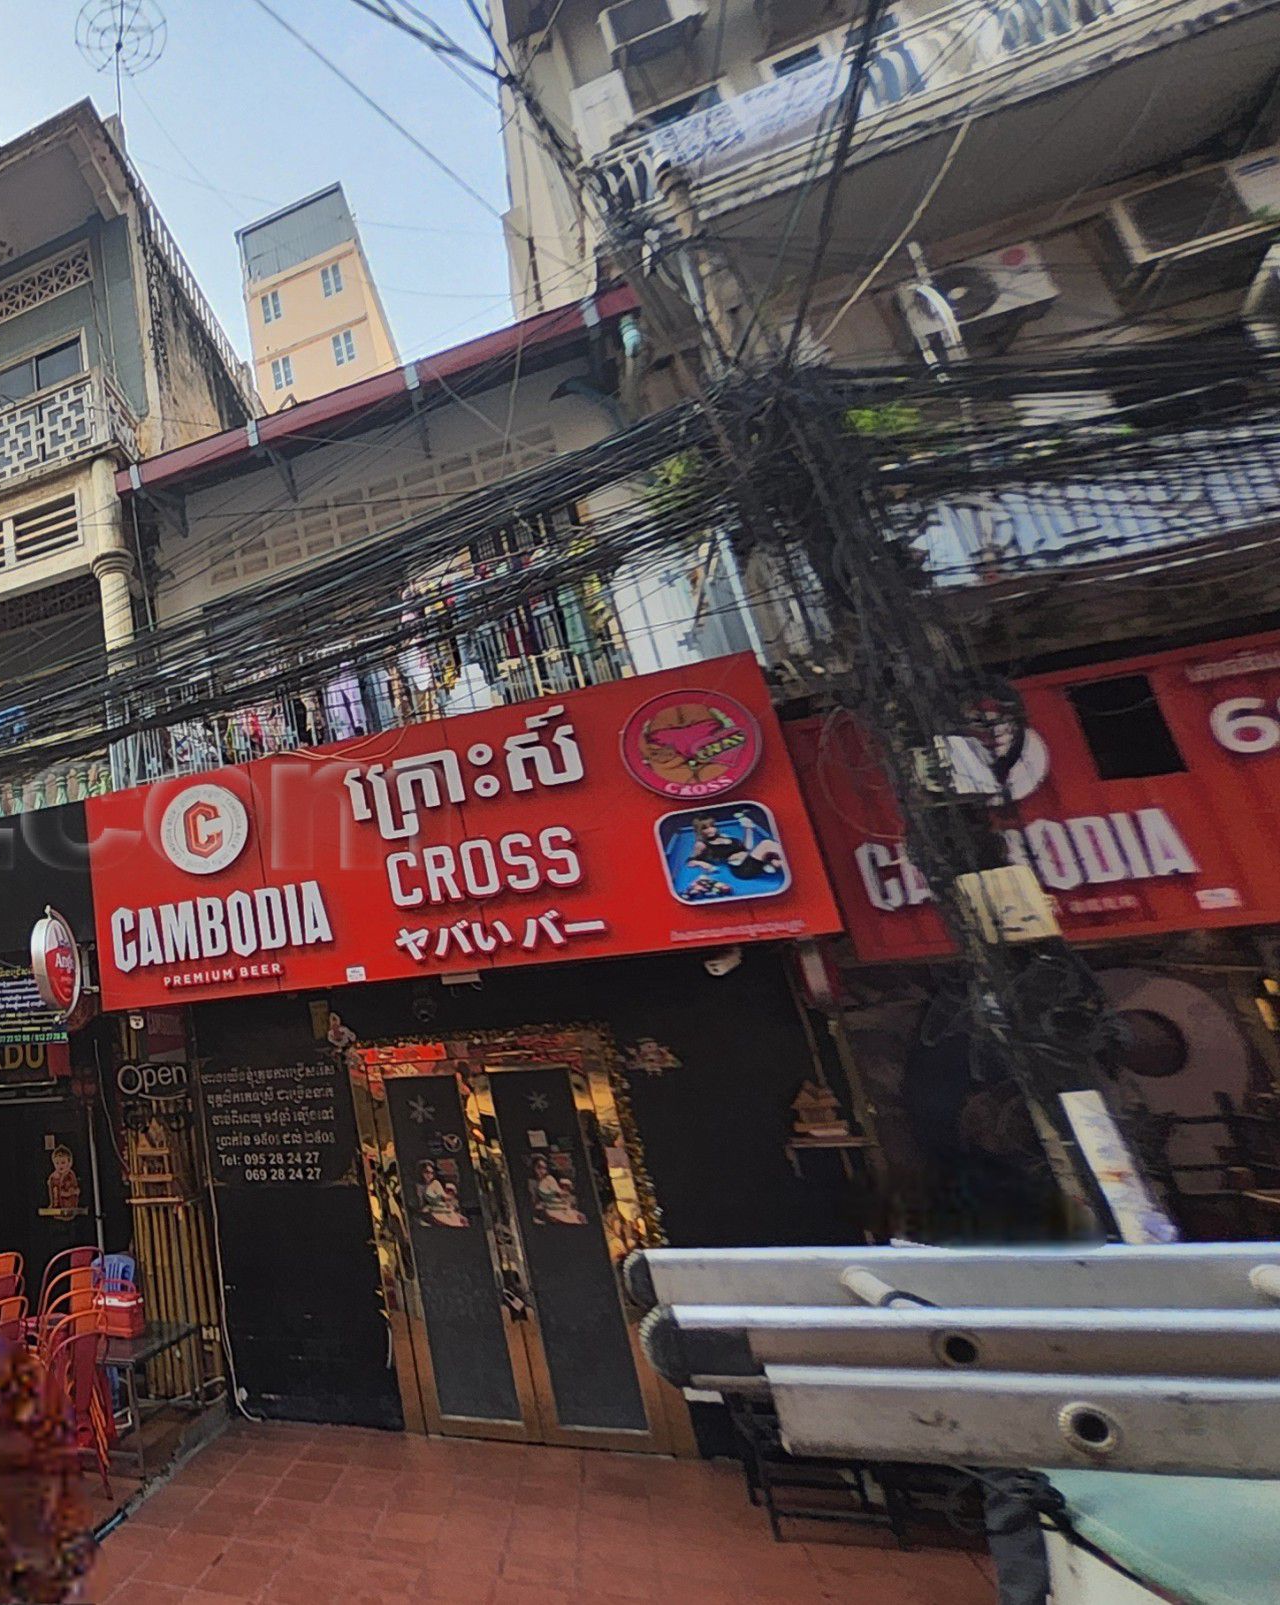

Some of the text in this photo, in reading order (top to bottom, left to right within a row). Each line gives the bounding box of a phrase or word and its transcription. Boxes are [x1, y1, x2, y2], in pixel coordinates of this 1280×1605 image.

[1210, 697, 1280, 753] 6
[665, 775, 734, 796] CROSS
[386, 826, 582, 908] CROSS
[855, 808, 1201, 912] CAODIA
[111, 880, 333, 973] CAMBODIA
[163, 963, 282, 987] PREMIUM BEER
[117, 1065, 187, 1095] Open
[220, 1152, 320, 1166] Tel: 095 28 24 27
[245, 1168, 321, 1180] 069 28 24 27
